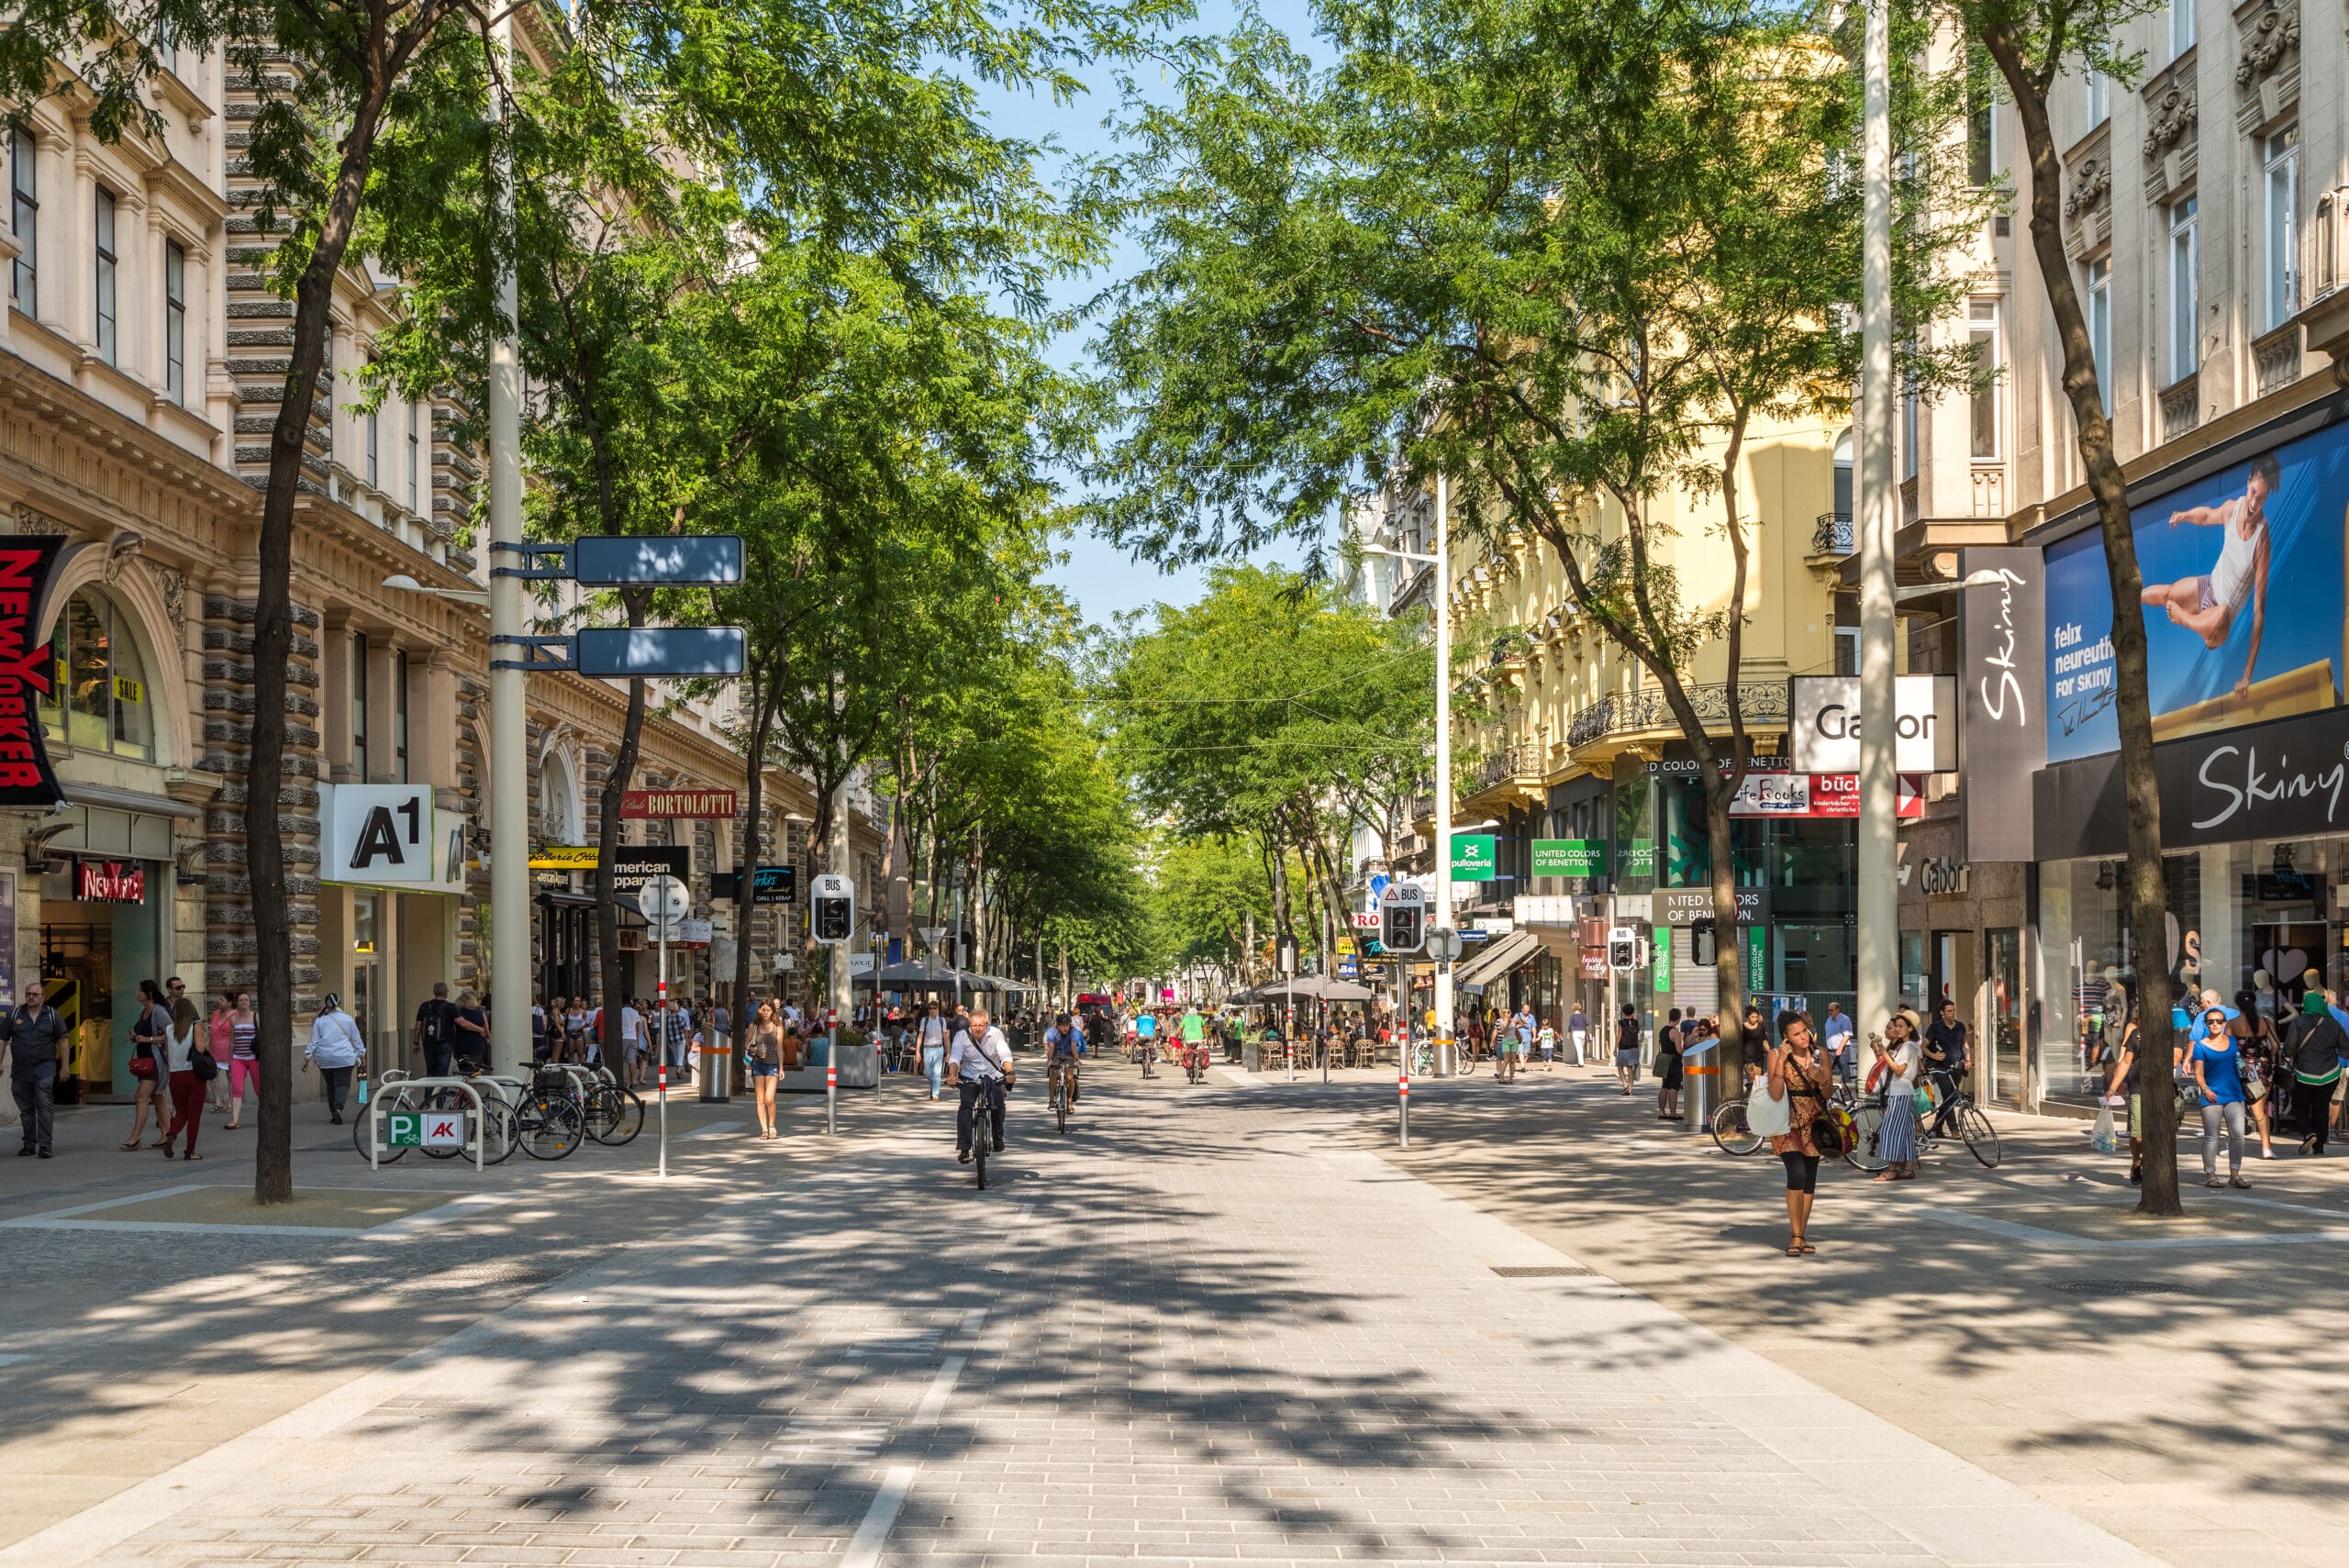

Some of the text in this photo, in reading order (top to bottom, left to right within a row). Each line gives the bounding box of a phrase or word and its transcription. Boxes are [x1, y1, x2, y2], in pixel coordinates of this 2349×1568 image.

[2054, 623, 2082, 650] felix
[1981, 568, 2026, 726] Skiny
[119, 679, 137, 701] SALE
[1816, 704, 1938, 740] Gaor
[1663, 761, 1700, 772] COLO
[1759, 779, 1805, 801] Books
[2191, 745, 2344, 828] Skiny
[648, 795, 732, 814] BORTOLOTTI
[350, 796, 419, 869] A1
[1535, 850, 1600, 858] UNITED COLORS
[614, 861, 671, 873] merican
[1452, 859, 1492, 869] pulloveria
[614, 874, 657, 889] ppar
[825, 879, 841, 891] BUS
[1920, 857, 1971, 895] Gabor
[1401, 888, 1418, 900] BUS
[1667, 910, 1685, 921] OF
[1616, 929, 1627, 938] BUS
[391, 1117, 413, 1143] P
[431, 1122, 455, 1138] AK
